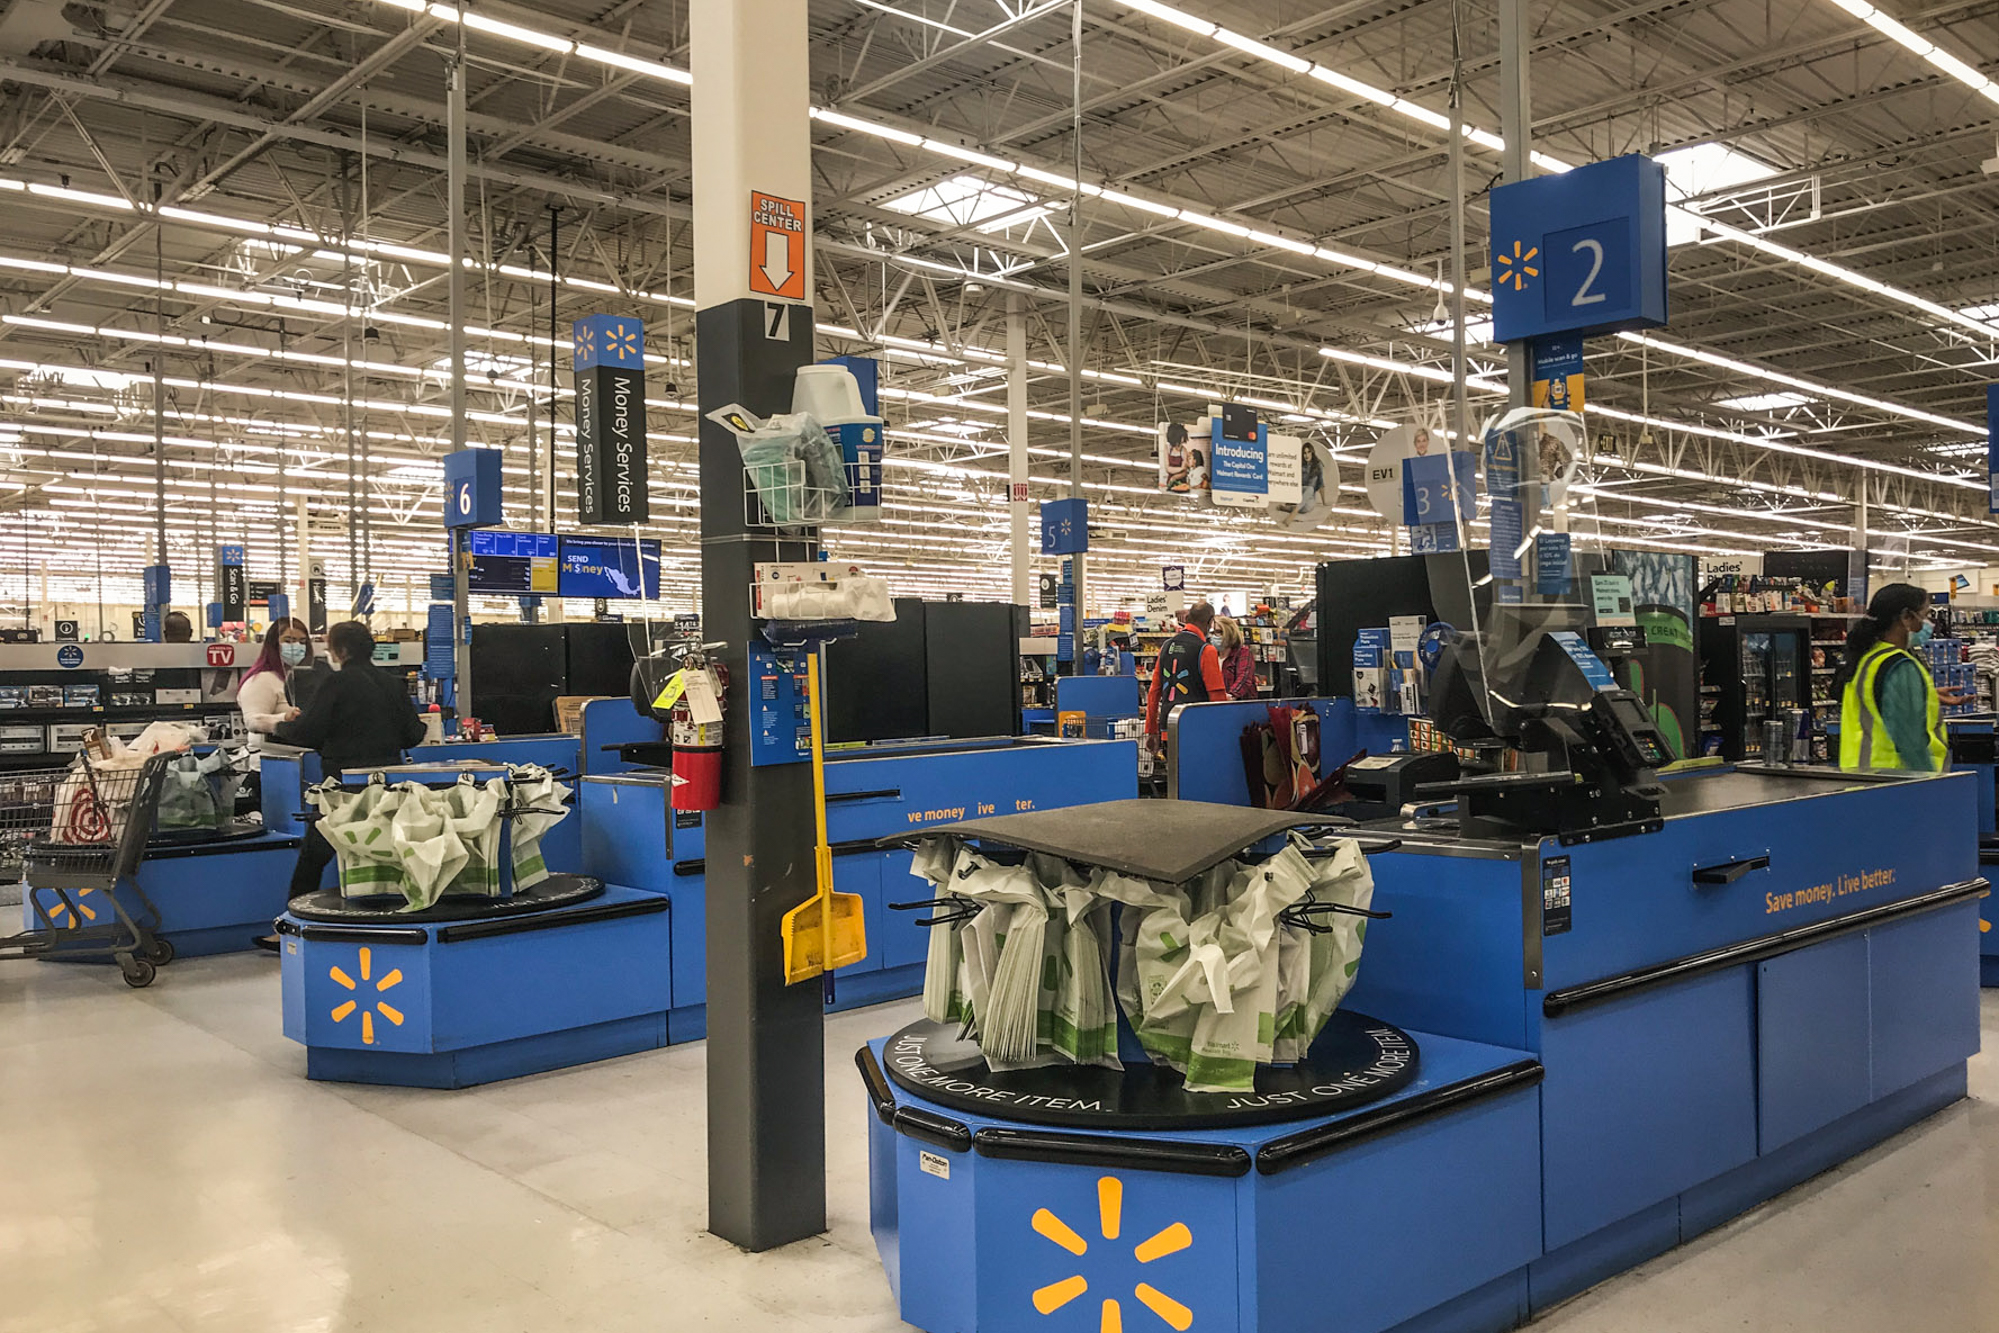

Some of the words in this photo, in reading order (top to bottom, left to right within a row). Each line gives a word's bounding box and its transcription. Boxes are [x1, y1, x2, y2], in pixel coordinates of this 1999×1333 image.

[760, 198, 794, 217] SPILL
[754, 210, 802, 232] CENTER
[1571, 239, 1606, 307] 2
[766, 302, 785, 337] 7
[580, 378, 592, 439] Money
[612, 376, 631, 439] Money
[1216, 443, 1264, 463] Introducing
[584, 444, 594, 514] Services
[616, 442, 634, 512] Services
[1372, 468, 1394, 480] EV1
[460, 483, 470, 514] 6
[1417, 487, 1430, 514] 3
[1048, 526, 1056, 548] 5
[229, 568, 238, 586] Scan
[1706, 561, 1743, 573] Ladies'
[230, 594, 239, 604] Go
[1147, 595, 1168, 604] Ladies'
[1147, 604, 1168, 612] Denim
[208, 650, 232, 664] TV
[924, 807, 965, 820] money
[978, 802, 995, 815] ive
[1016, 800, 1035, 810] ter.
[1765, 892, 1793, 914] Save
[1795, 883, 1836, 906] money.
[1838, 874, 1860, 896] Live
[894, 1034, 927, 1054] JUST
[896, 1056, 939, 1078] ONE
[922, 1073, 1016, 1101] MORE
[1227, 1091, 1307, 1109] JUST
[1311, 1075, 1380, 1096] ONE
[1363, 1049, 1410, 1078] MORE
